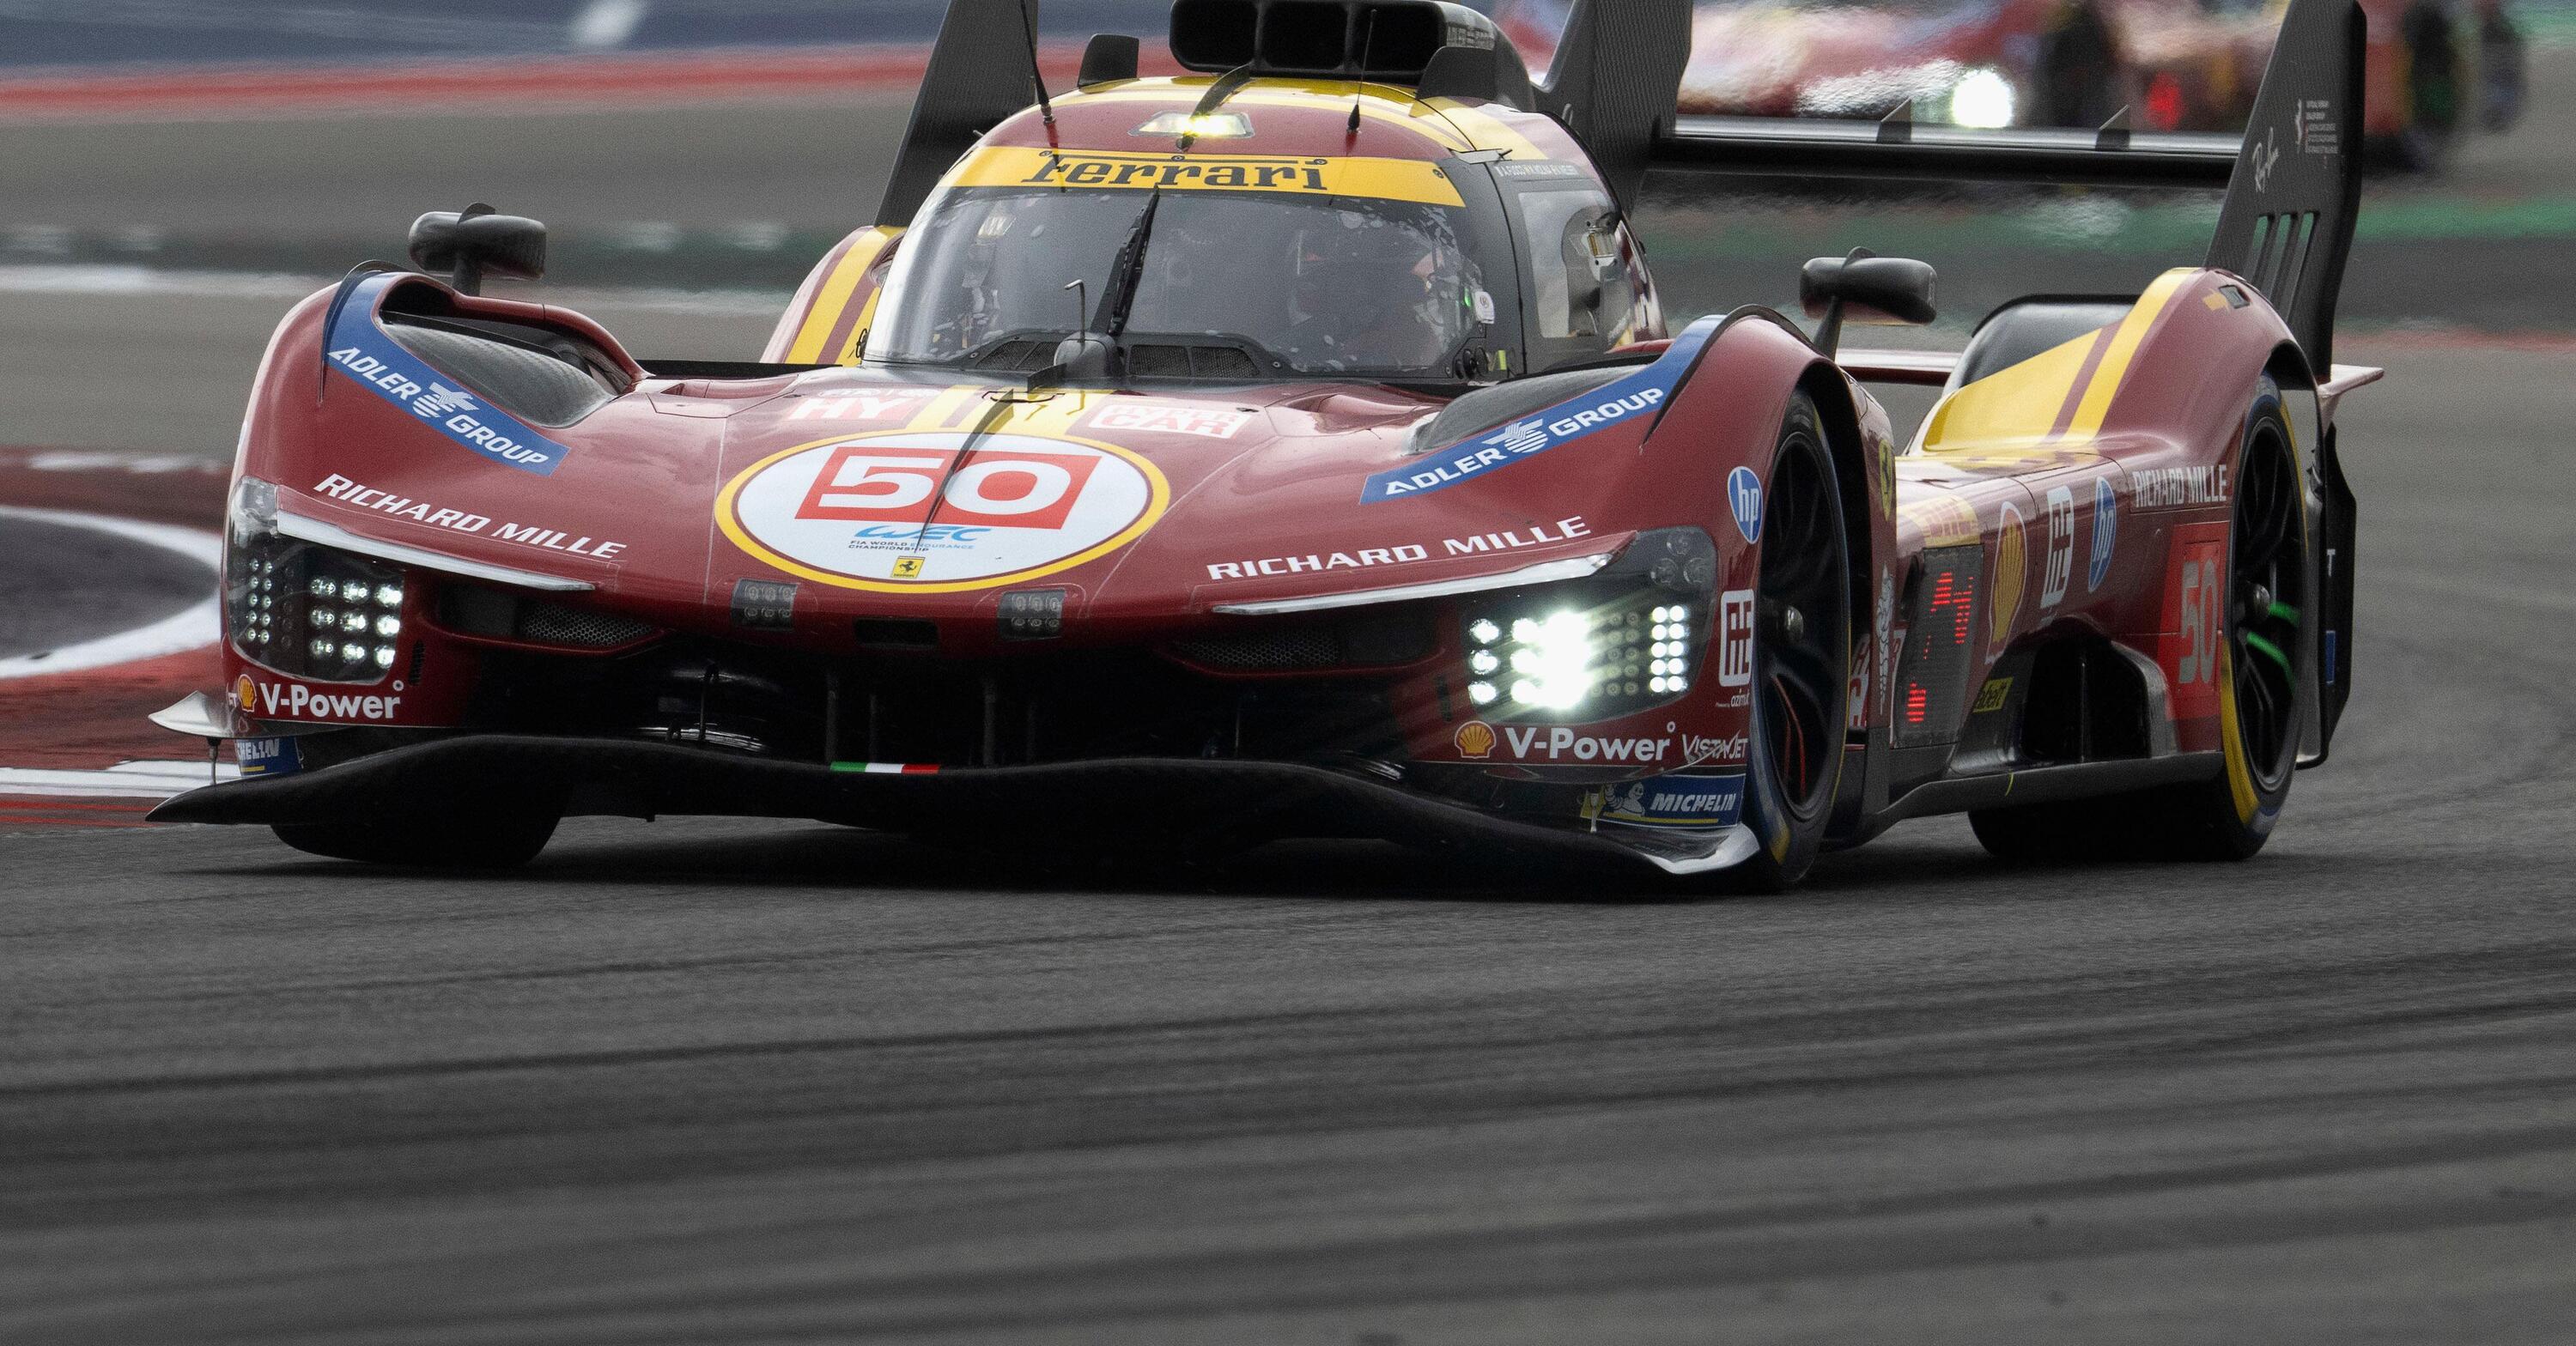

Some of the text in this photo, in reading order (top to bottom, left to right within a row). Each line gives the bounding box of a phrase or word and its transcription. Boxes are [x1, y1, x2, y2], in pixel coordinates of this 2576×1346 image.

[1021, 153, 1328, 191] Ferrari
[327, 347, 549, 466] ADLER GROUP
[1102, 414, 1229, 435] CAR
[1386, 388, 1664, 495] ADLER GROUP
[818, 455, 1071, 515] 50
[1736, 468, 1760, 543] hp
[2132, 464, 2227, 508] RICHARD MILLE
[314, 473, 627, 559] RICHARD MILLE
[854, 524, 992, 542] WEC
[1206, 515, 1591, 581] RICHARD MILLE
[2179, 558, 2219, 684] 50
[259, 682, 400, 719] V-Power
[1504, 726, 1670, 762] V-Power
[1649, 792, 1737, 813] MICHELIN
